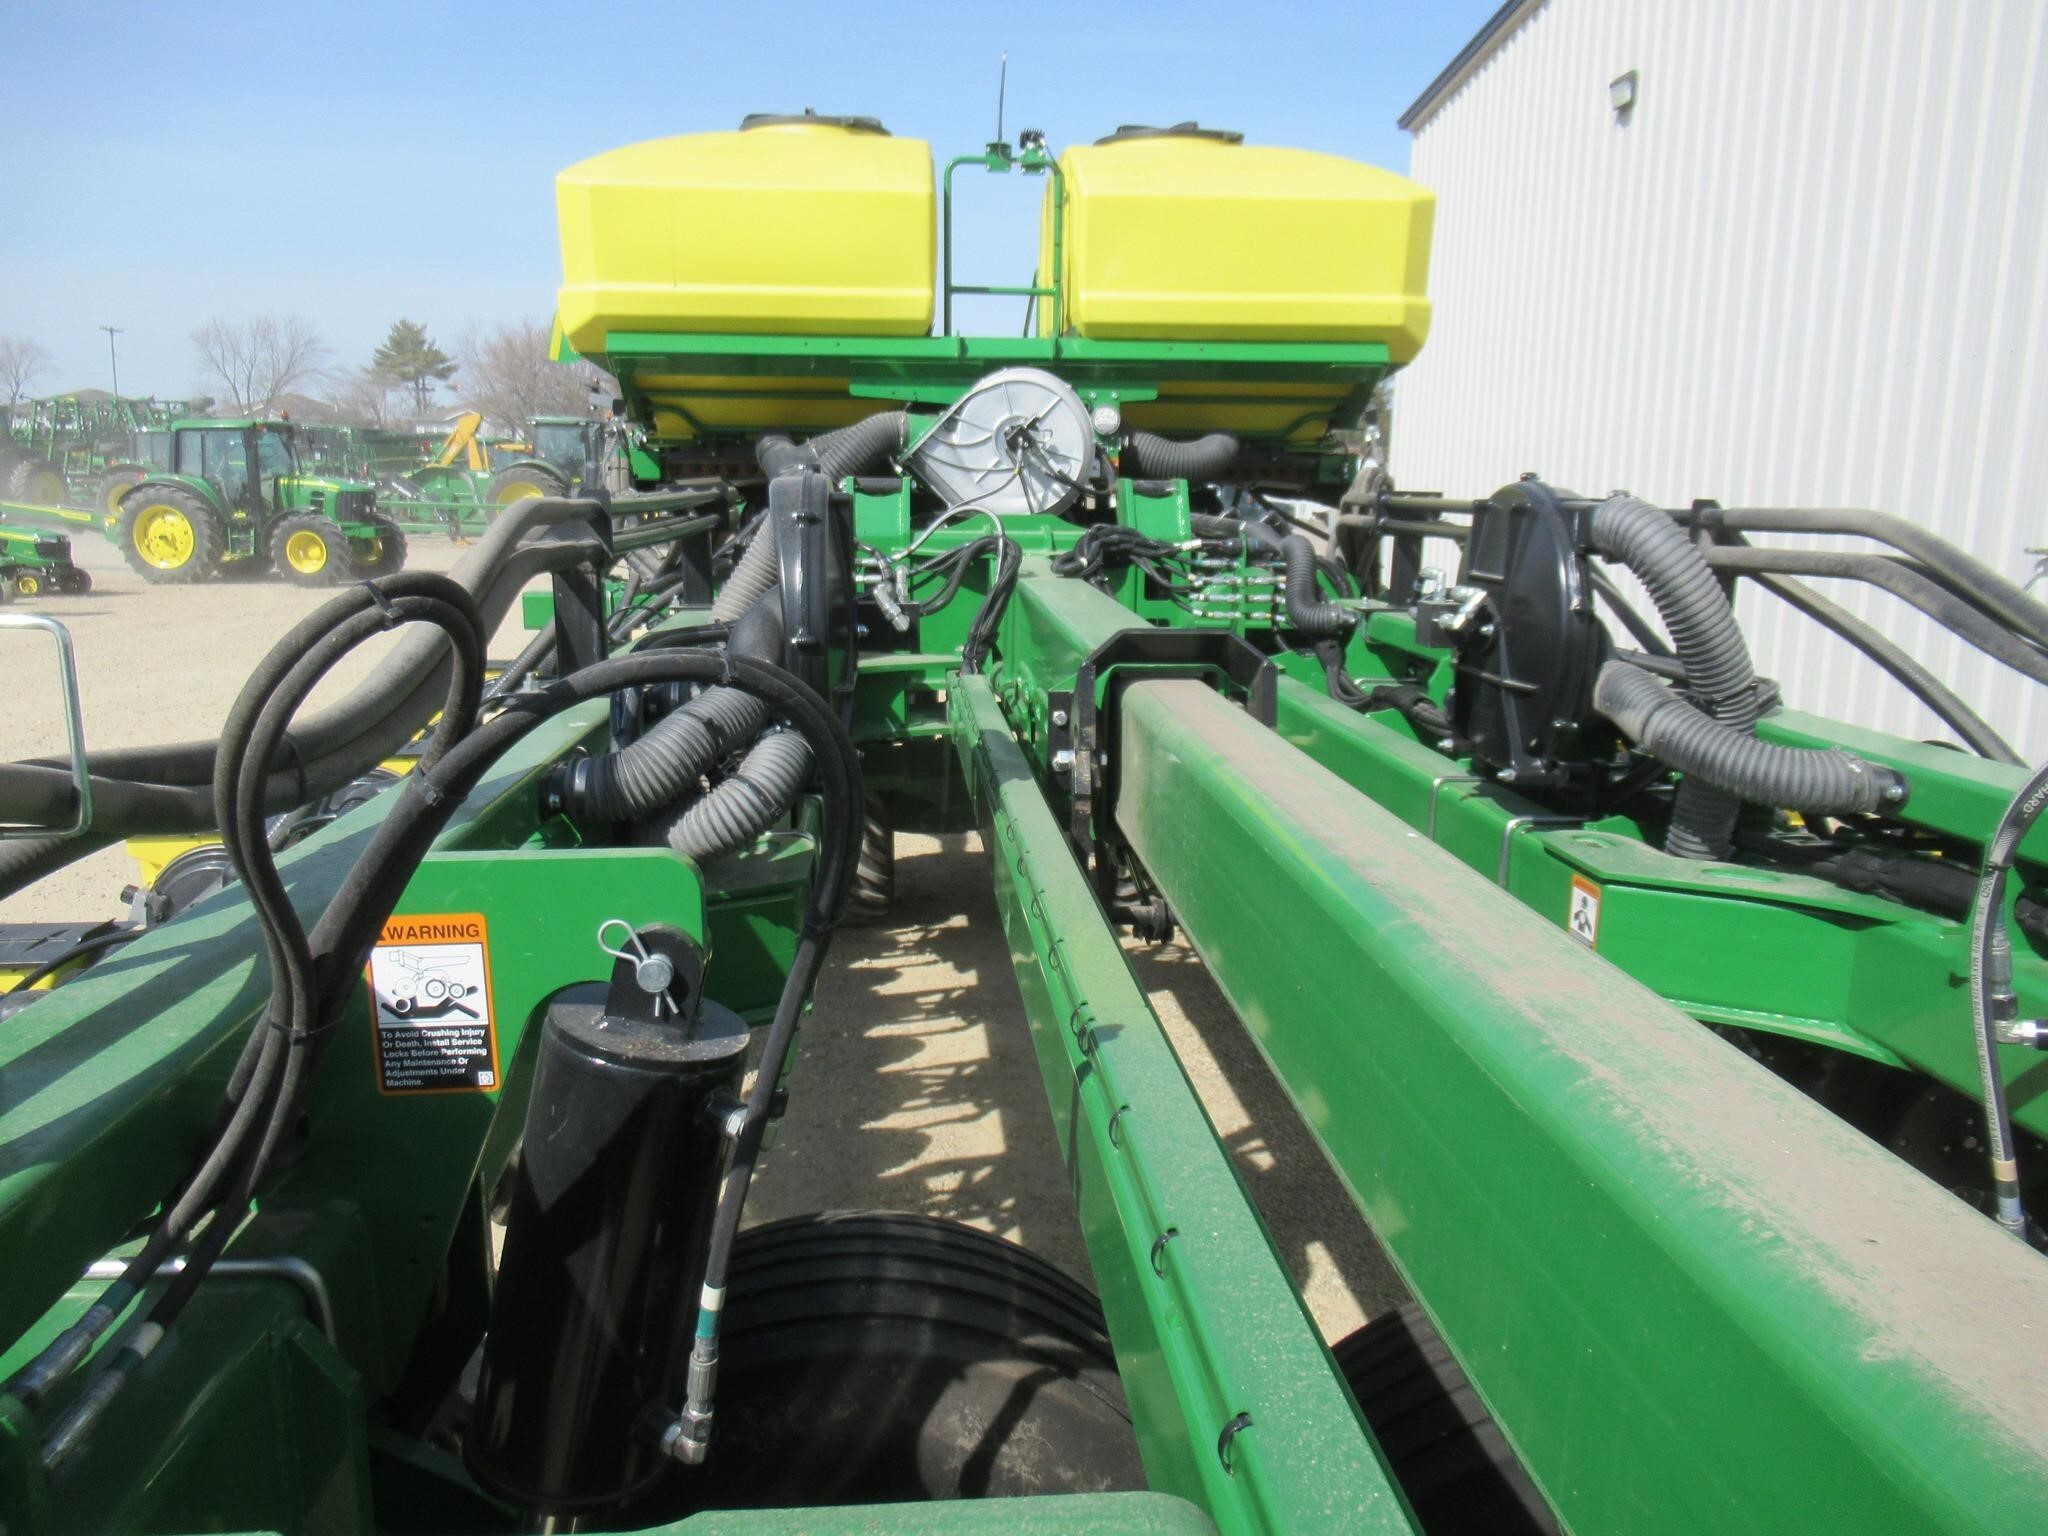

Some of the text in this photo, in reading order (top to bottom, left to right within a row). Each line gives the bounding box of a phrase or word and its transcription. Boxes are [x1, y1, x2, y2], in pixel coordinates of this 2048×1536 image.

[387, 923, 480, 940] WARNING
[395, 1030, 419, 1038] Avoid
[421, 1028, 460, 1038] Crushing
[461, 1028, 485, 1037] Injury
[424, 1038, 450, 1046] Install
[384, 1050, 409, 1058] Locks
[441, 1048, 487, 1056] Performing
[385, 1060, 400, 1068] Any
[403, 1059, 456, 1067] Maintenance
[386, 1069, 438, 1078] Adjustments
